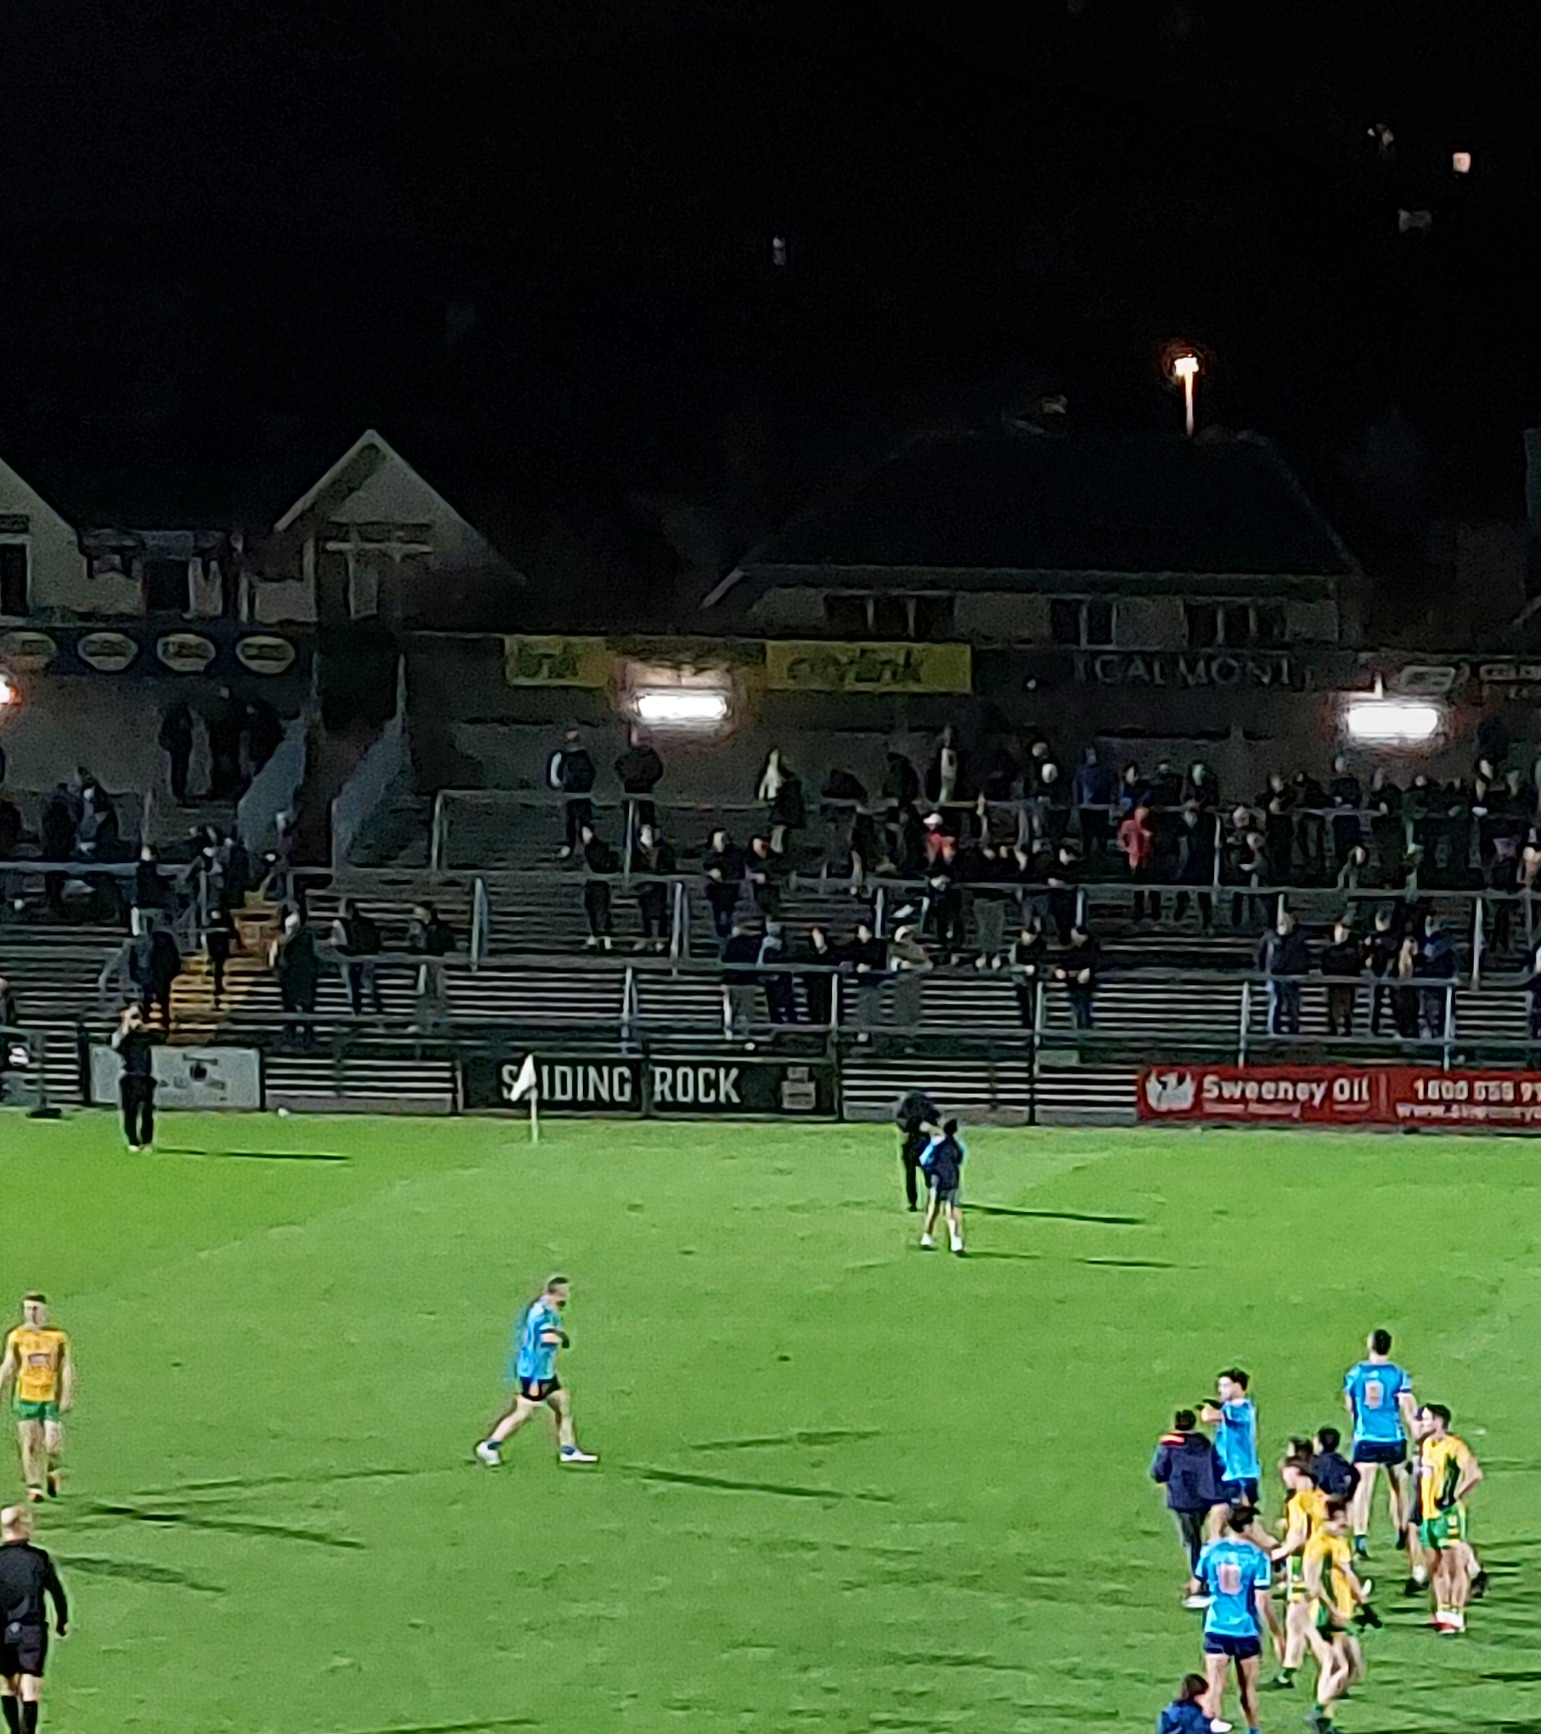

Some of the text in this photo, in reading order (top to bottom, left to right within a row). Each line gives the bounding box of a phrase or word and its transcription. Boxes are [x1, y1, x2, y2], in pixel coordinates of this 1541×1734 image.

[501, 1064, 741, 1104] SIDING ROCK
[1202, 1074, 1369, 1108] Sweeney Oil
